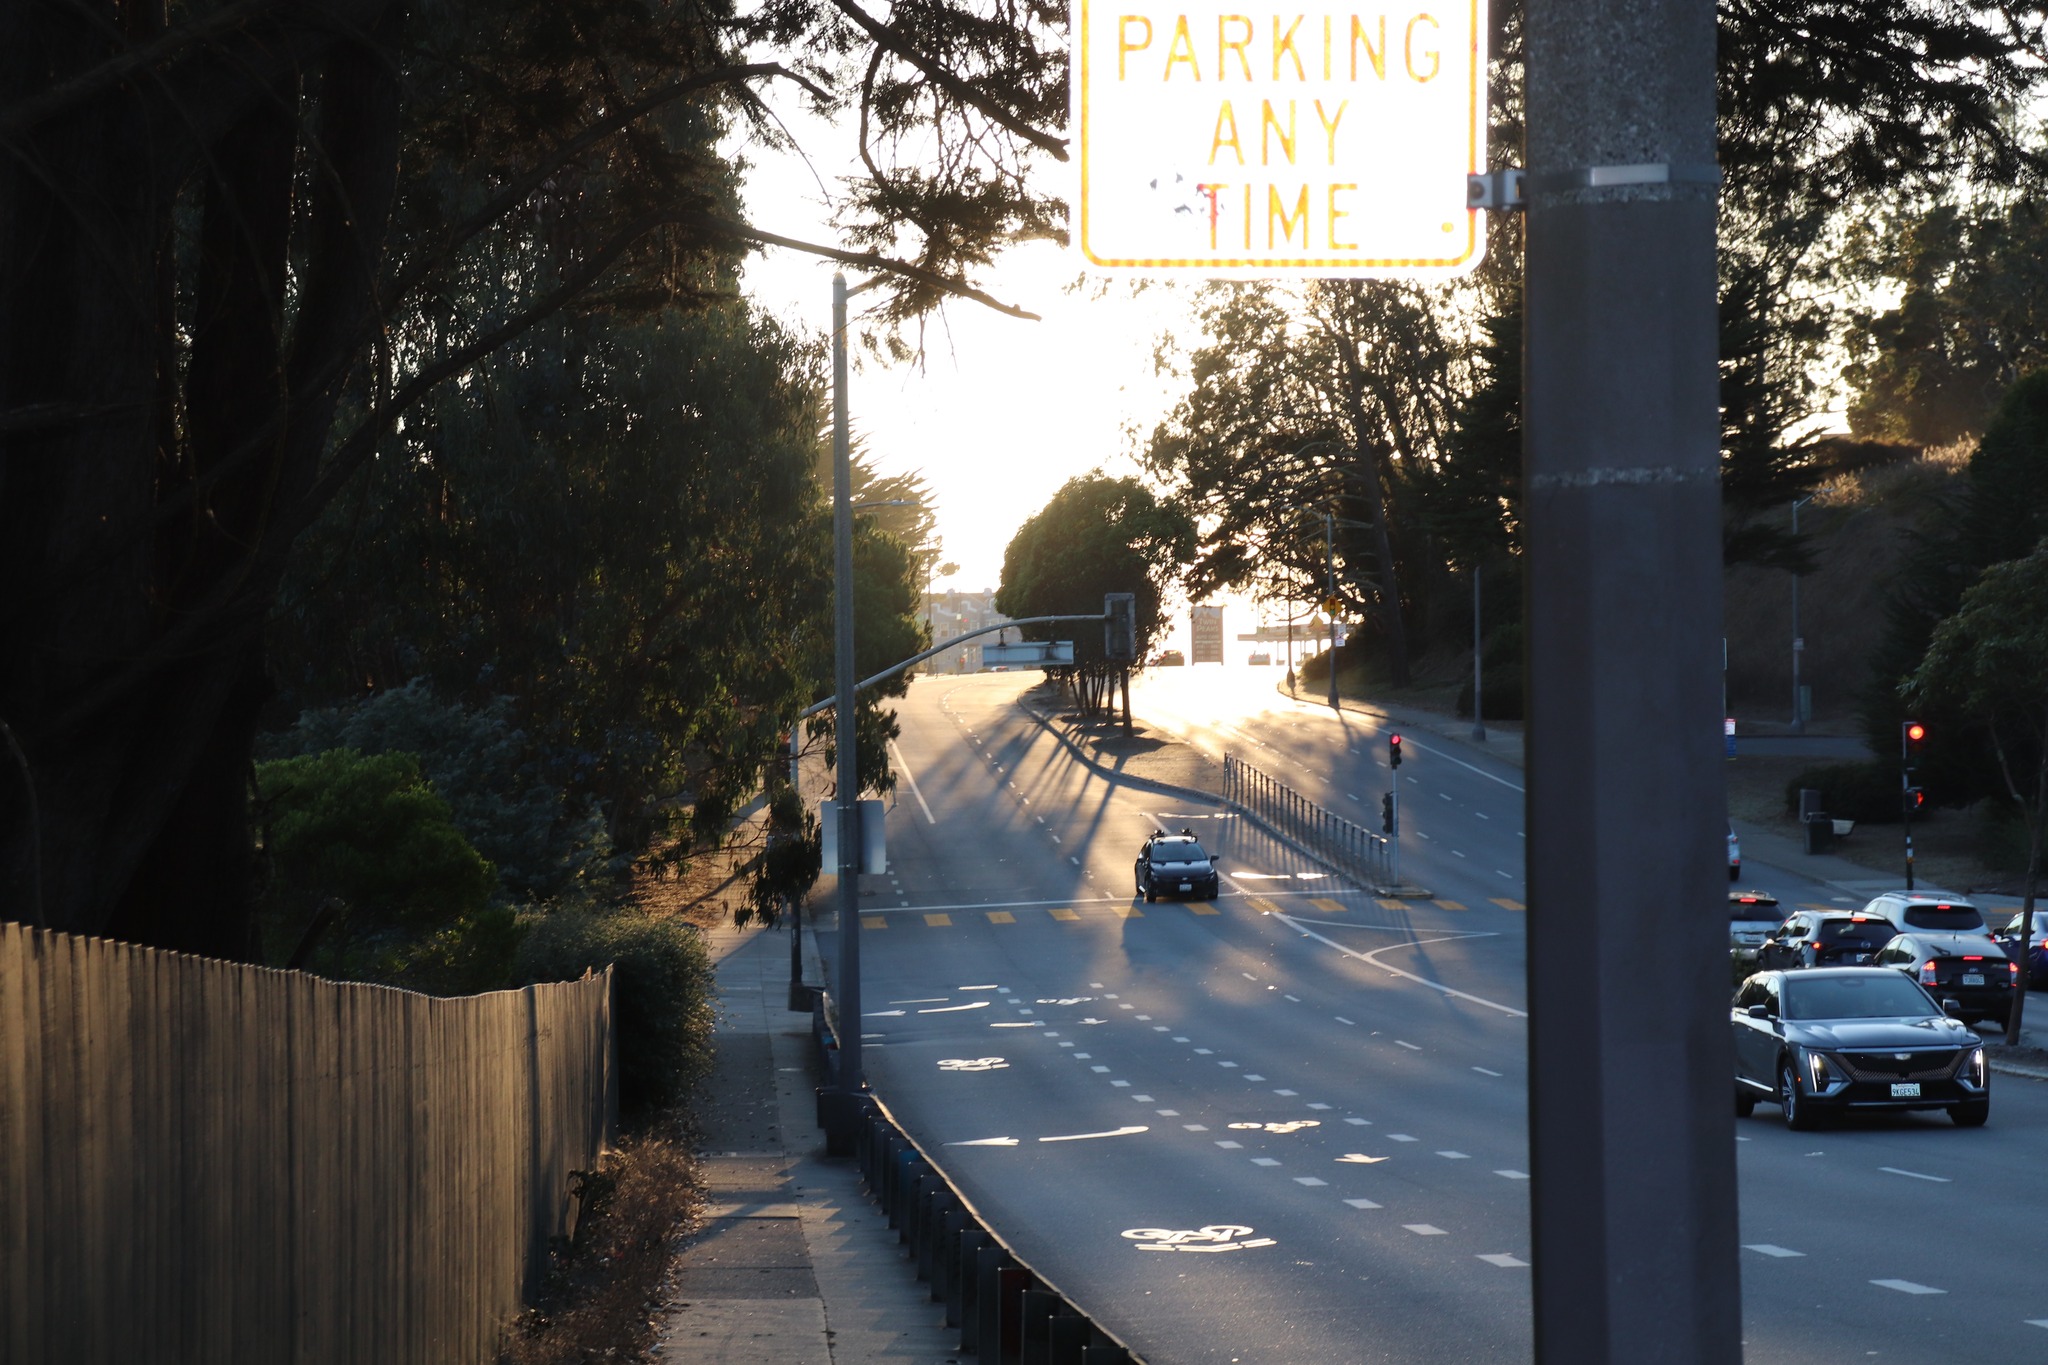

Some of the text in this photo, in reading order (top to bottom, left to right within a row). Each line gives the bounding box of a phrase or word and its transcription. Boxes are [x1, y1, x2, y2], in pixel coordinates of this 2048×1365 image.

[1118, 13, 1441, 83] PARKING
[1207, 98, 1350, 166] ANY
[1196, 183, 1359, 250] TIME
